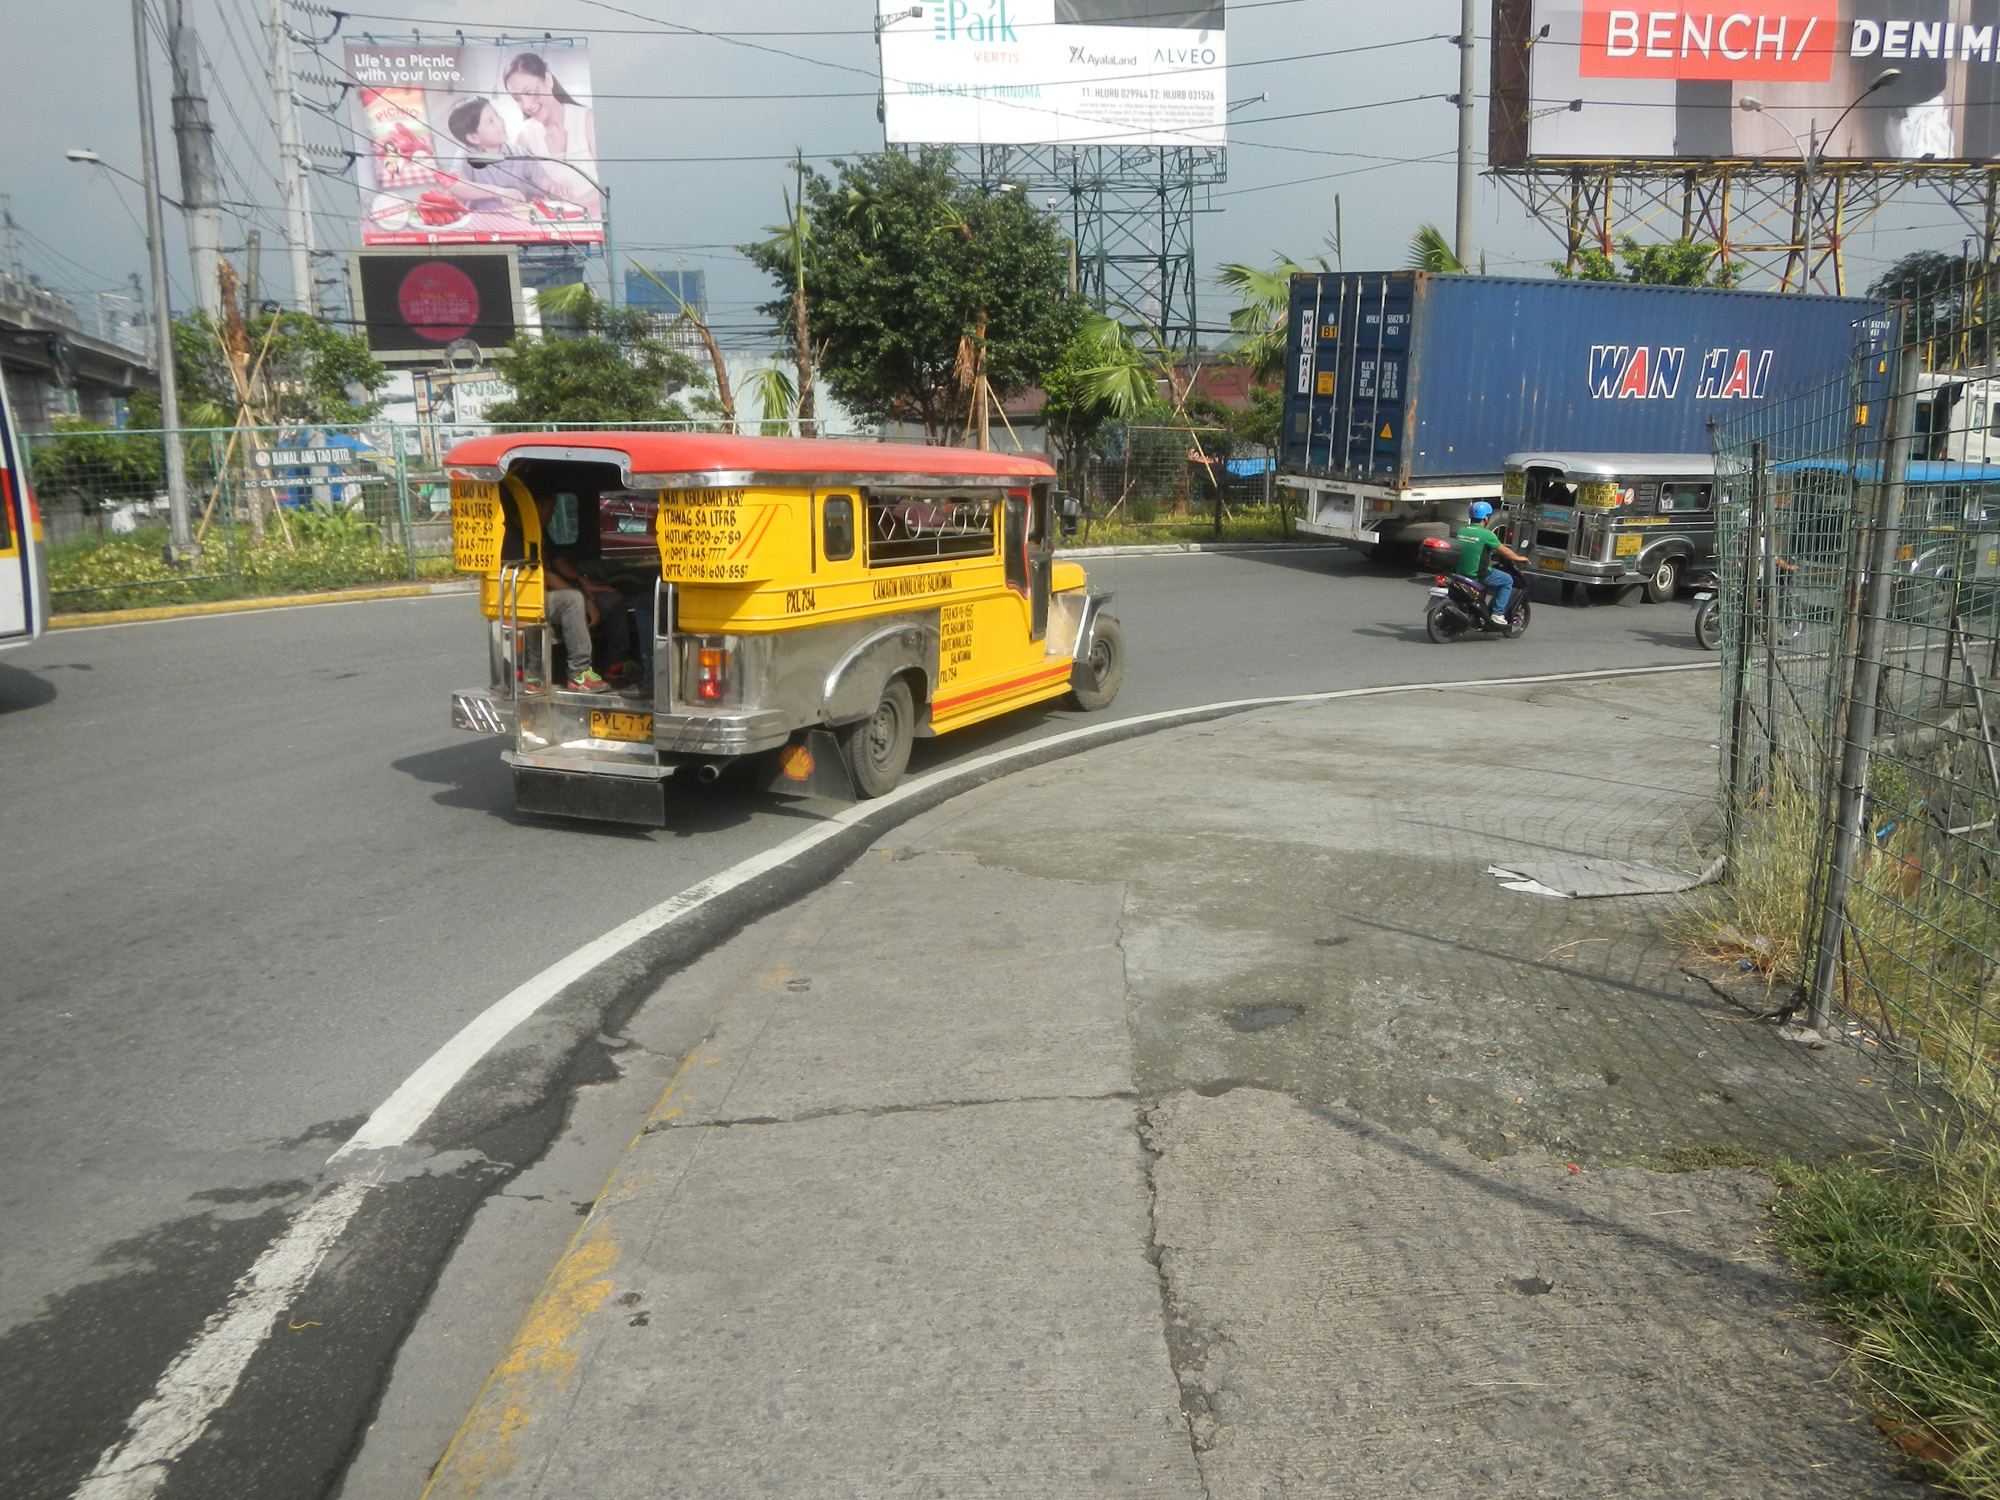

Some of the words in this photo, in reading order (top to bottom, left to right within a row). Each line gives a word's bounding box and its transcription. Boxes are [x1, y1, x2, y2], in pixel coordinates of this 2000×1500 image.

[949, 0, 1018, 42] Park
[1606, 11, 1818, 61] BENCH/
[1850, 19, 2000, 62] DENIM
[354, 54, 391, 67] Life's
[395, 57, 406, 67] a
[409, 54, 454, 68] Picnic
[974, 51, 1020, 63] VERTIS
[1154, 48, 1215, 65] ALVEO
[356, 69, 387, 81] with
[391, 70, 424, 84] your
[428, 68, 464, 81] love.
[907, 82, 934, 96] VISIT
[938, 83, 953, 97] US
[957, 84, 968, 97] AT
[993, 84, 1041, 98] TRINOMA
[1095, 88, 1119, 98] HLURB
[1121, 88, 1148, 99] 029944
[1163, 89, 1186, 100] HLURB
[1188, 90, 1215, 101] 031526
[375, 106, 419, 122] PICNIC
[1302, 315, 1312, 347] WAN
[1323, 326, 1336, 337] B1
[1301, 357, 1309, 388] HAI
[1588, 345, 1685, 399] WAN
[1695, 348, 1773, 399] HAI
[272, 451, 299, 465] BAWAL
[301, 450, 316, 464] ANG
[316, 449, 331, 463] TAO
[261, 478, 303, 487] CROSSING
[327, 475, 372, 483] UNDERPASS
[663, 489, 679, 504] MAY
[684, 489, 722, 507] REKLAMO
[727, 489, 744, 507] KA?
[461, 503, 469, 518] SA
[664, 509, 692, 526] ITAWAG
[695, 509, 707, 527] SA
[710, 510, 736, 527] LTFRB
[786, 590, 801, 613] PXL
[802, 588, 816, 611] 734
